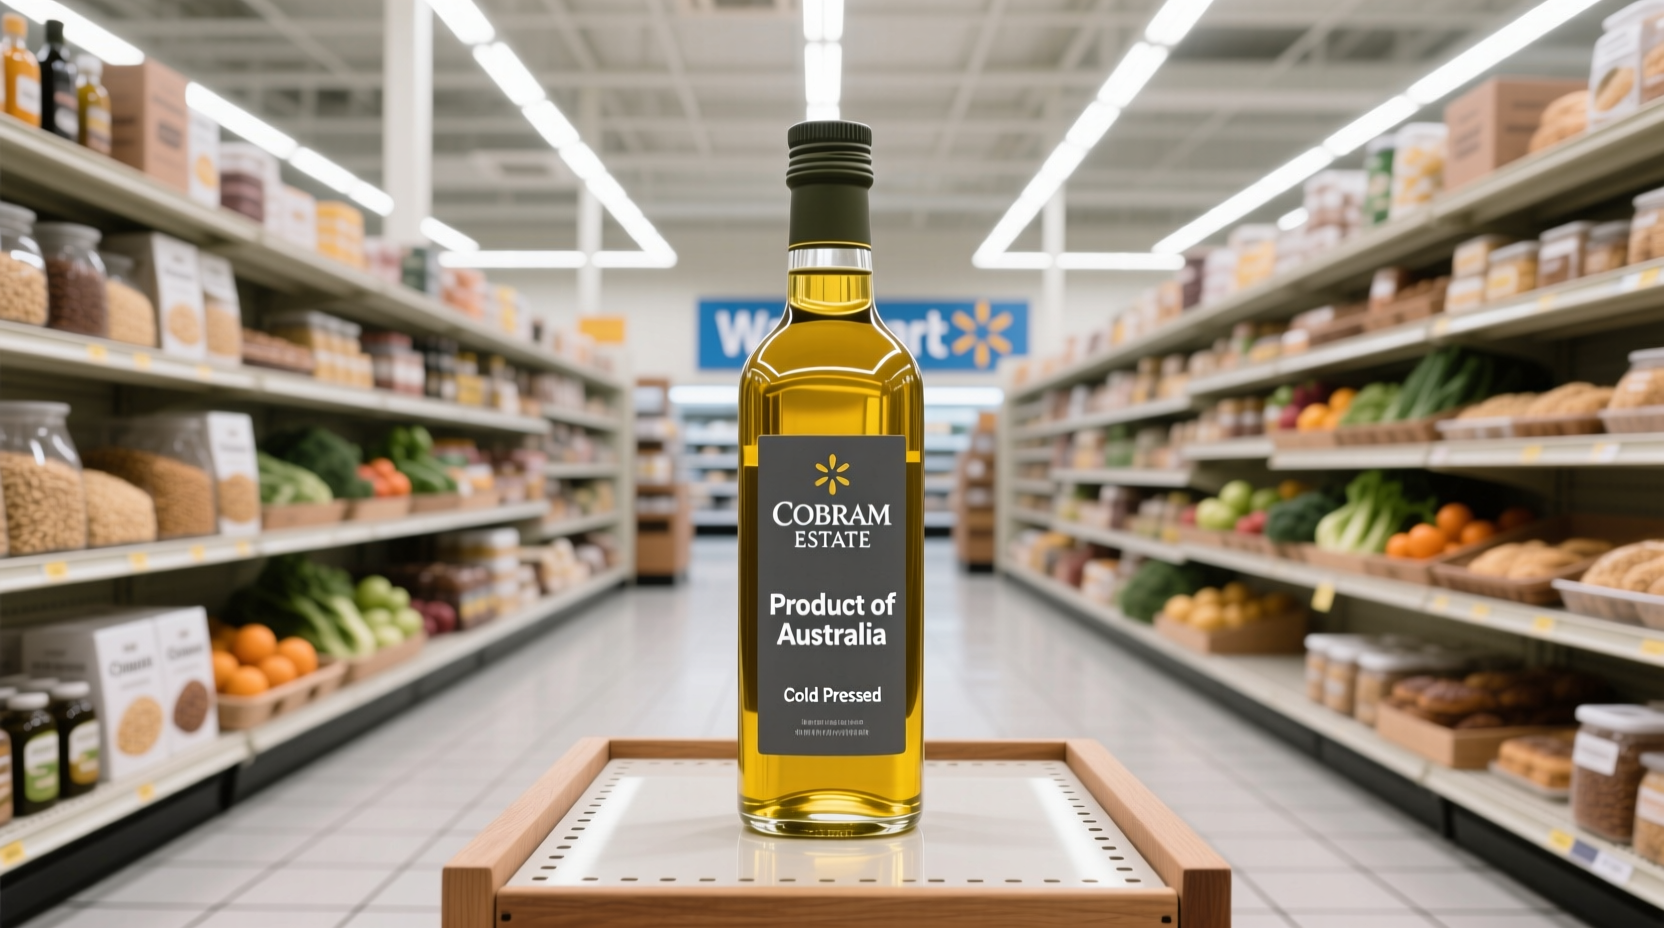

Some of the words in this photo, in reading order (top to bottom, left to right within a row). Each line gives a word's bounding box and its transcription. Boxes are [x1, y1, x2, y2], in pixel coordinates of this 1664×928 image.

[794, 530, 871, 549] ESTATE
[769, 592, 866, 617] Product
[870, 591, 897, 617] of
[776, 622, 887, 647] Australia
[783, 685, 819, 704] Cold
[823, 685, 882, 704] Pressed
